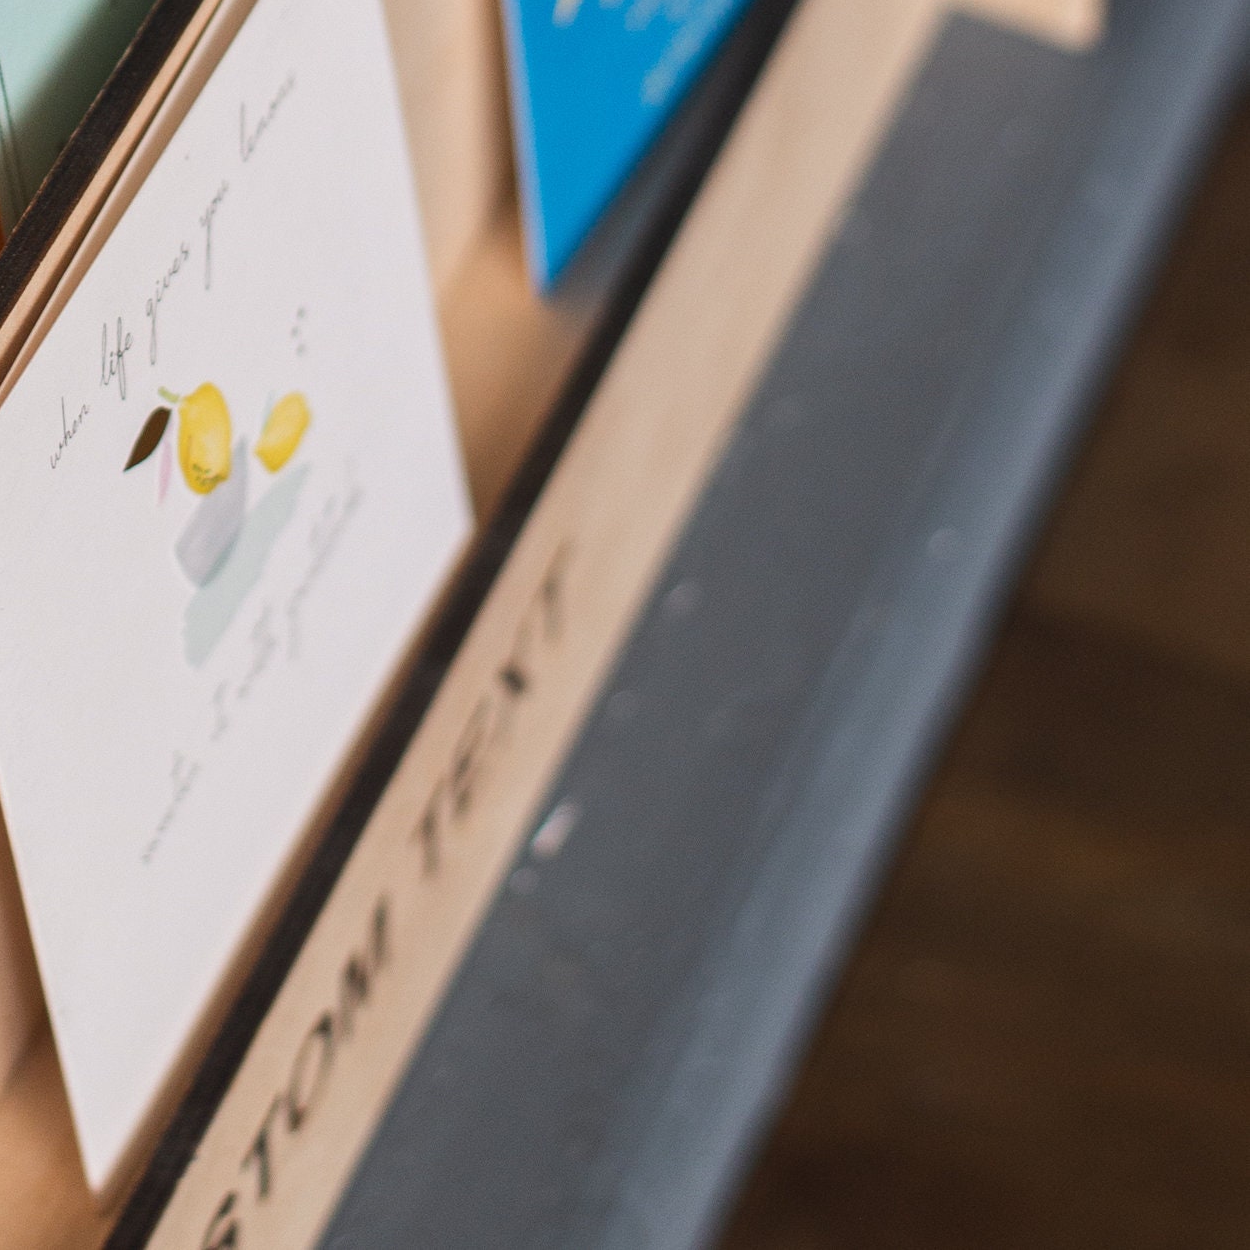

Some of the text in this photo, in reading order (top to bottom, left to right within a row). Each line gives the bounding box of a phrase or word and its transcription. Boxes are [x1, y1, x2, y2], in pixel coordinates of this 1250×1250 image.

[50, 396, 90, 469] when
[100, 316, 133, 401] life
[146, 240, 190, 366] gives
[200, 180, 229, 290] you
